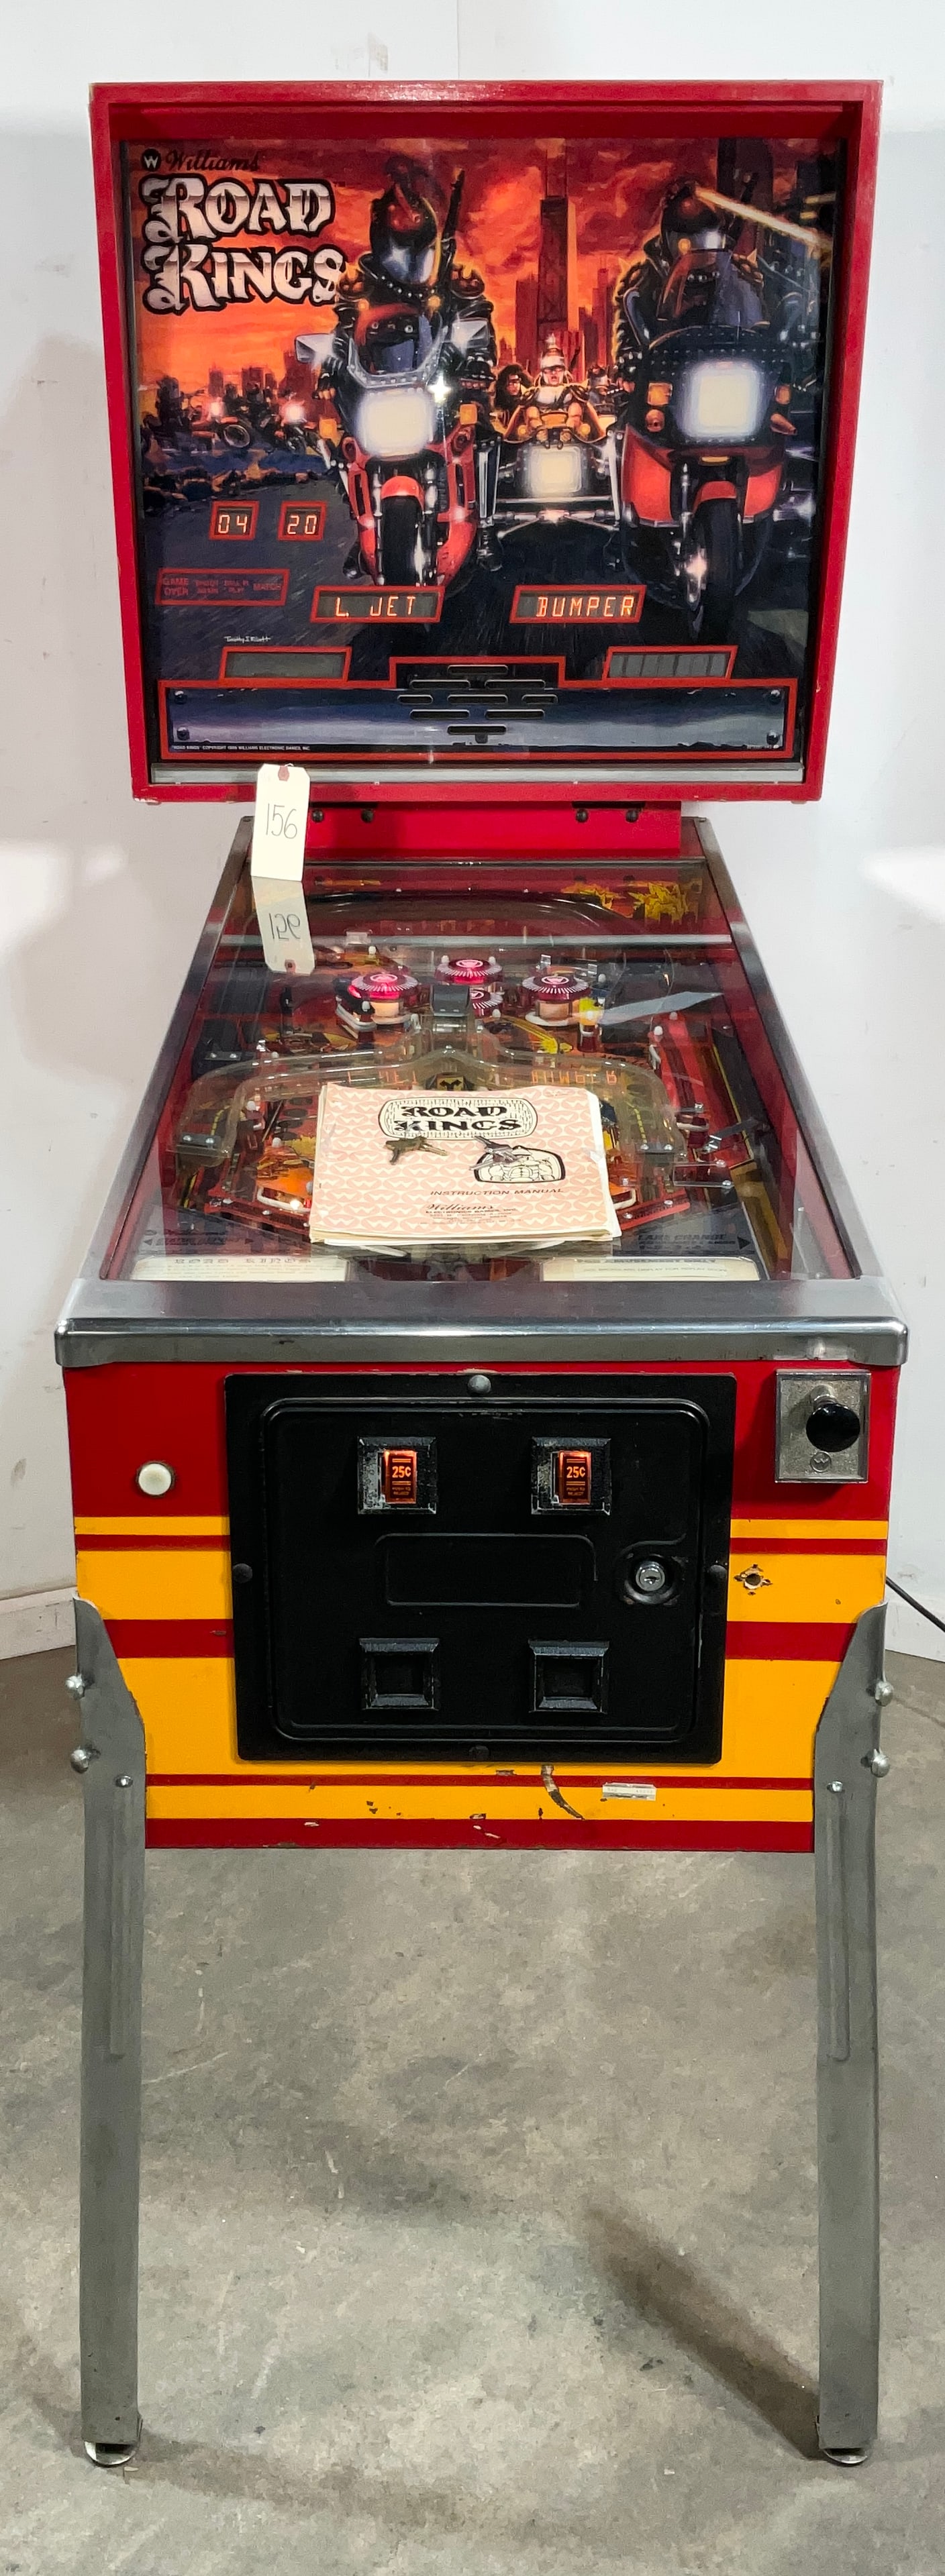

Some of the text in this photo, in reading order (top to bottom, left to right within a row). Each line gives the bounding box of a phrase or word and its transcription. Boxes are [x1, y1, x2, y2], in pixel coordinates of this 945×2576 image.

[164, 149, 260, 171] Williams
[140, 174, 334, 242] ROAD
[141, 242, 345, 314] KINGS
[218, 515, 248, 534] 04
[287, 515, 317, 535] 20
[370, 596, 416, 616] JET
[536, 596, 635, 618] BUMPER
[266, 803, 297, 839] 156
[400, 1106, 507, 1118] ROAD
[394, 1119, 522, 1131] KINGS
[392, 1466, 411, 1479] 25¢
[566, 1466, 586, 1479] 25¢
